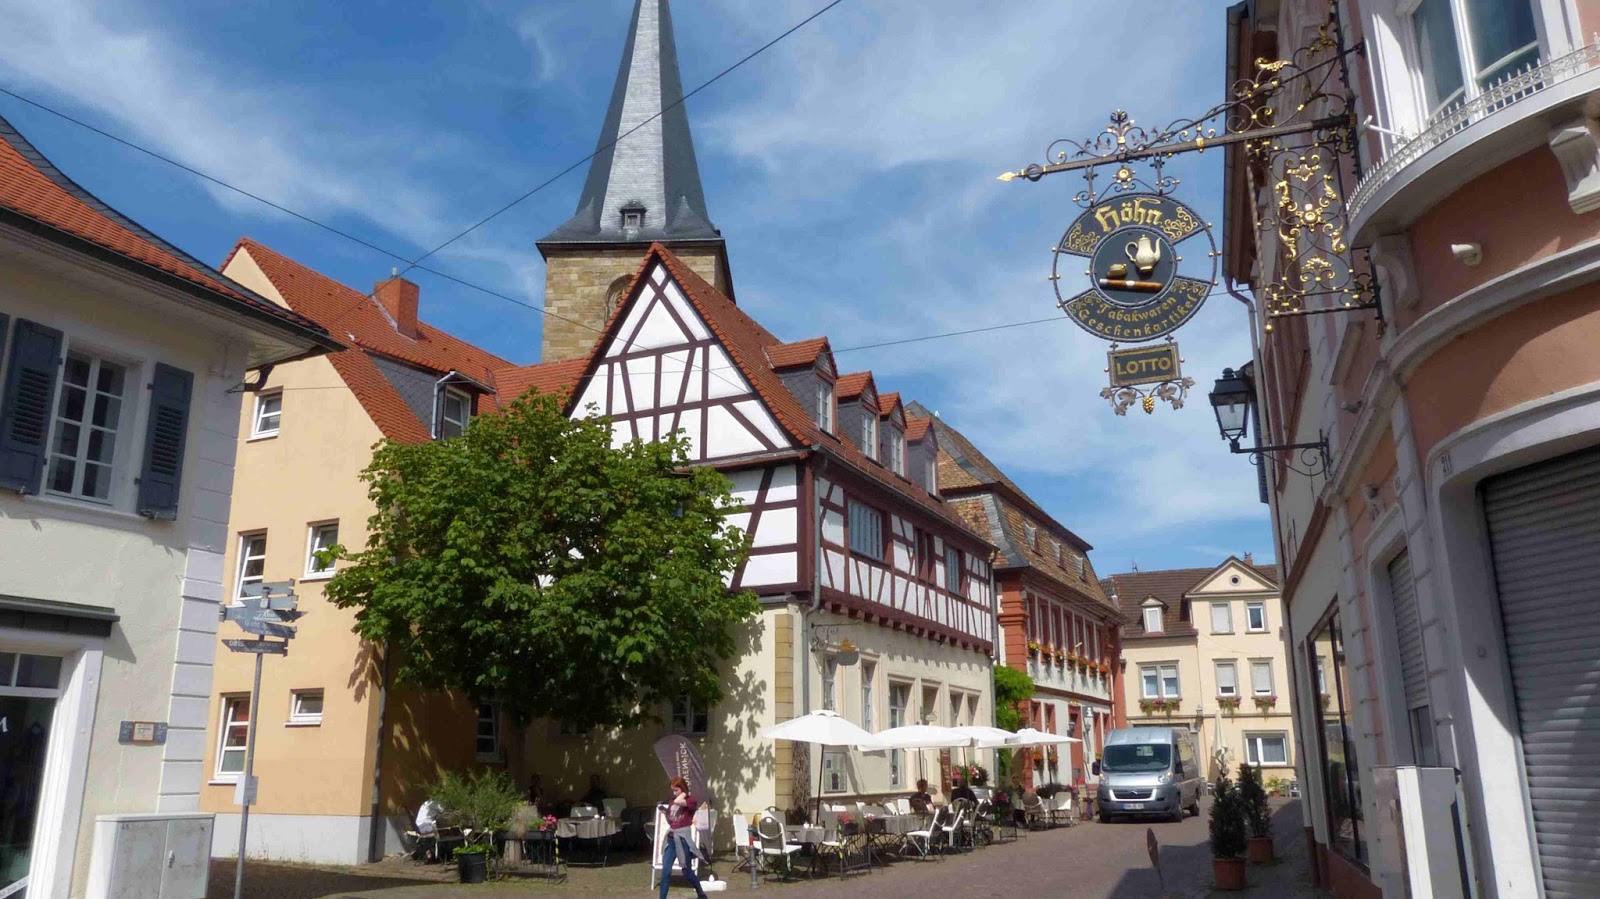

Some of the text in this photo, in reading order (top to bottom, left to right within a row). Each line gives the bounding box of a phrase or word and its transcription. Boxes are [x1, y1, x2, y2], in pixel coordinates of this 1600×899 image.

[1095, 197, 1162, 232] Höhn
[1079, 294, 1198, 336] Geschenkartikel
[1097, 296, 1177, 322] Tabakwaren
[1117, 357, 1171, 375] LOTTO
